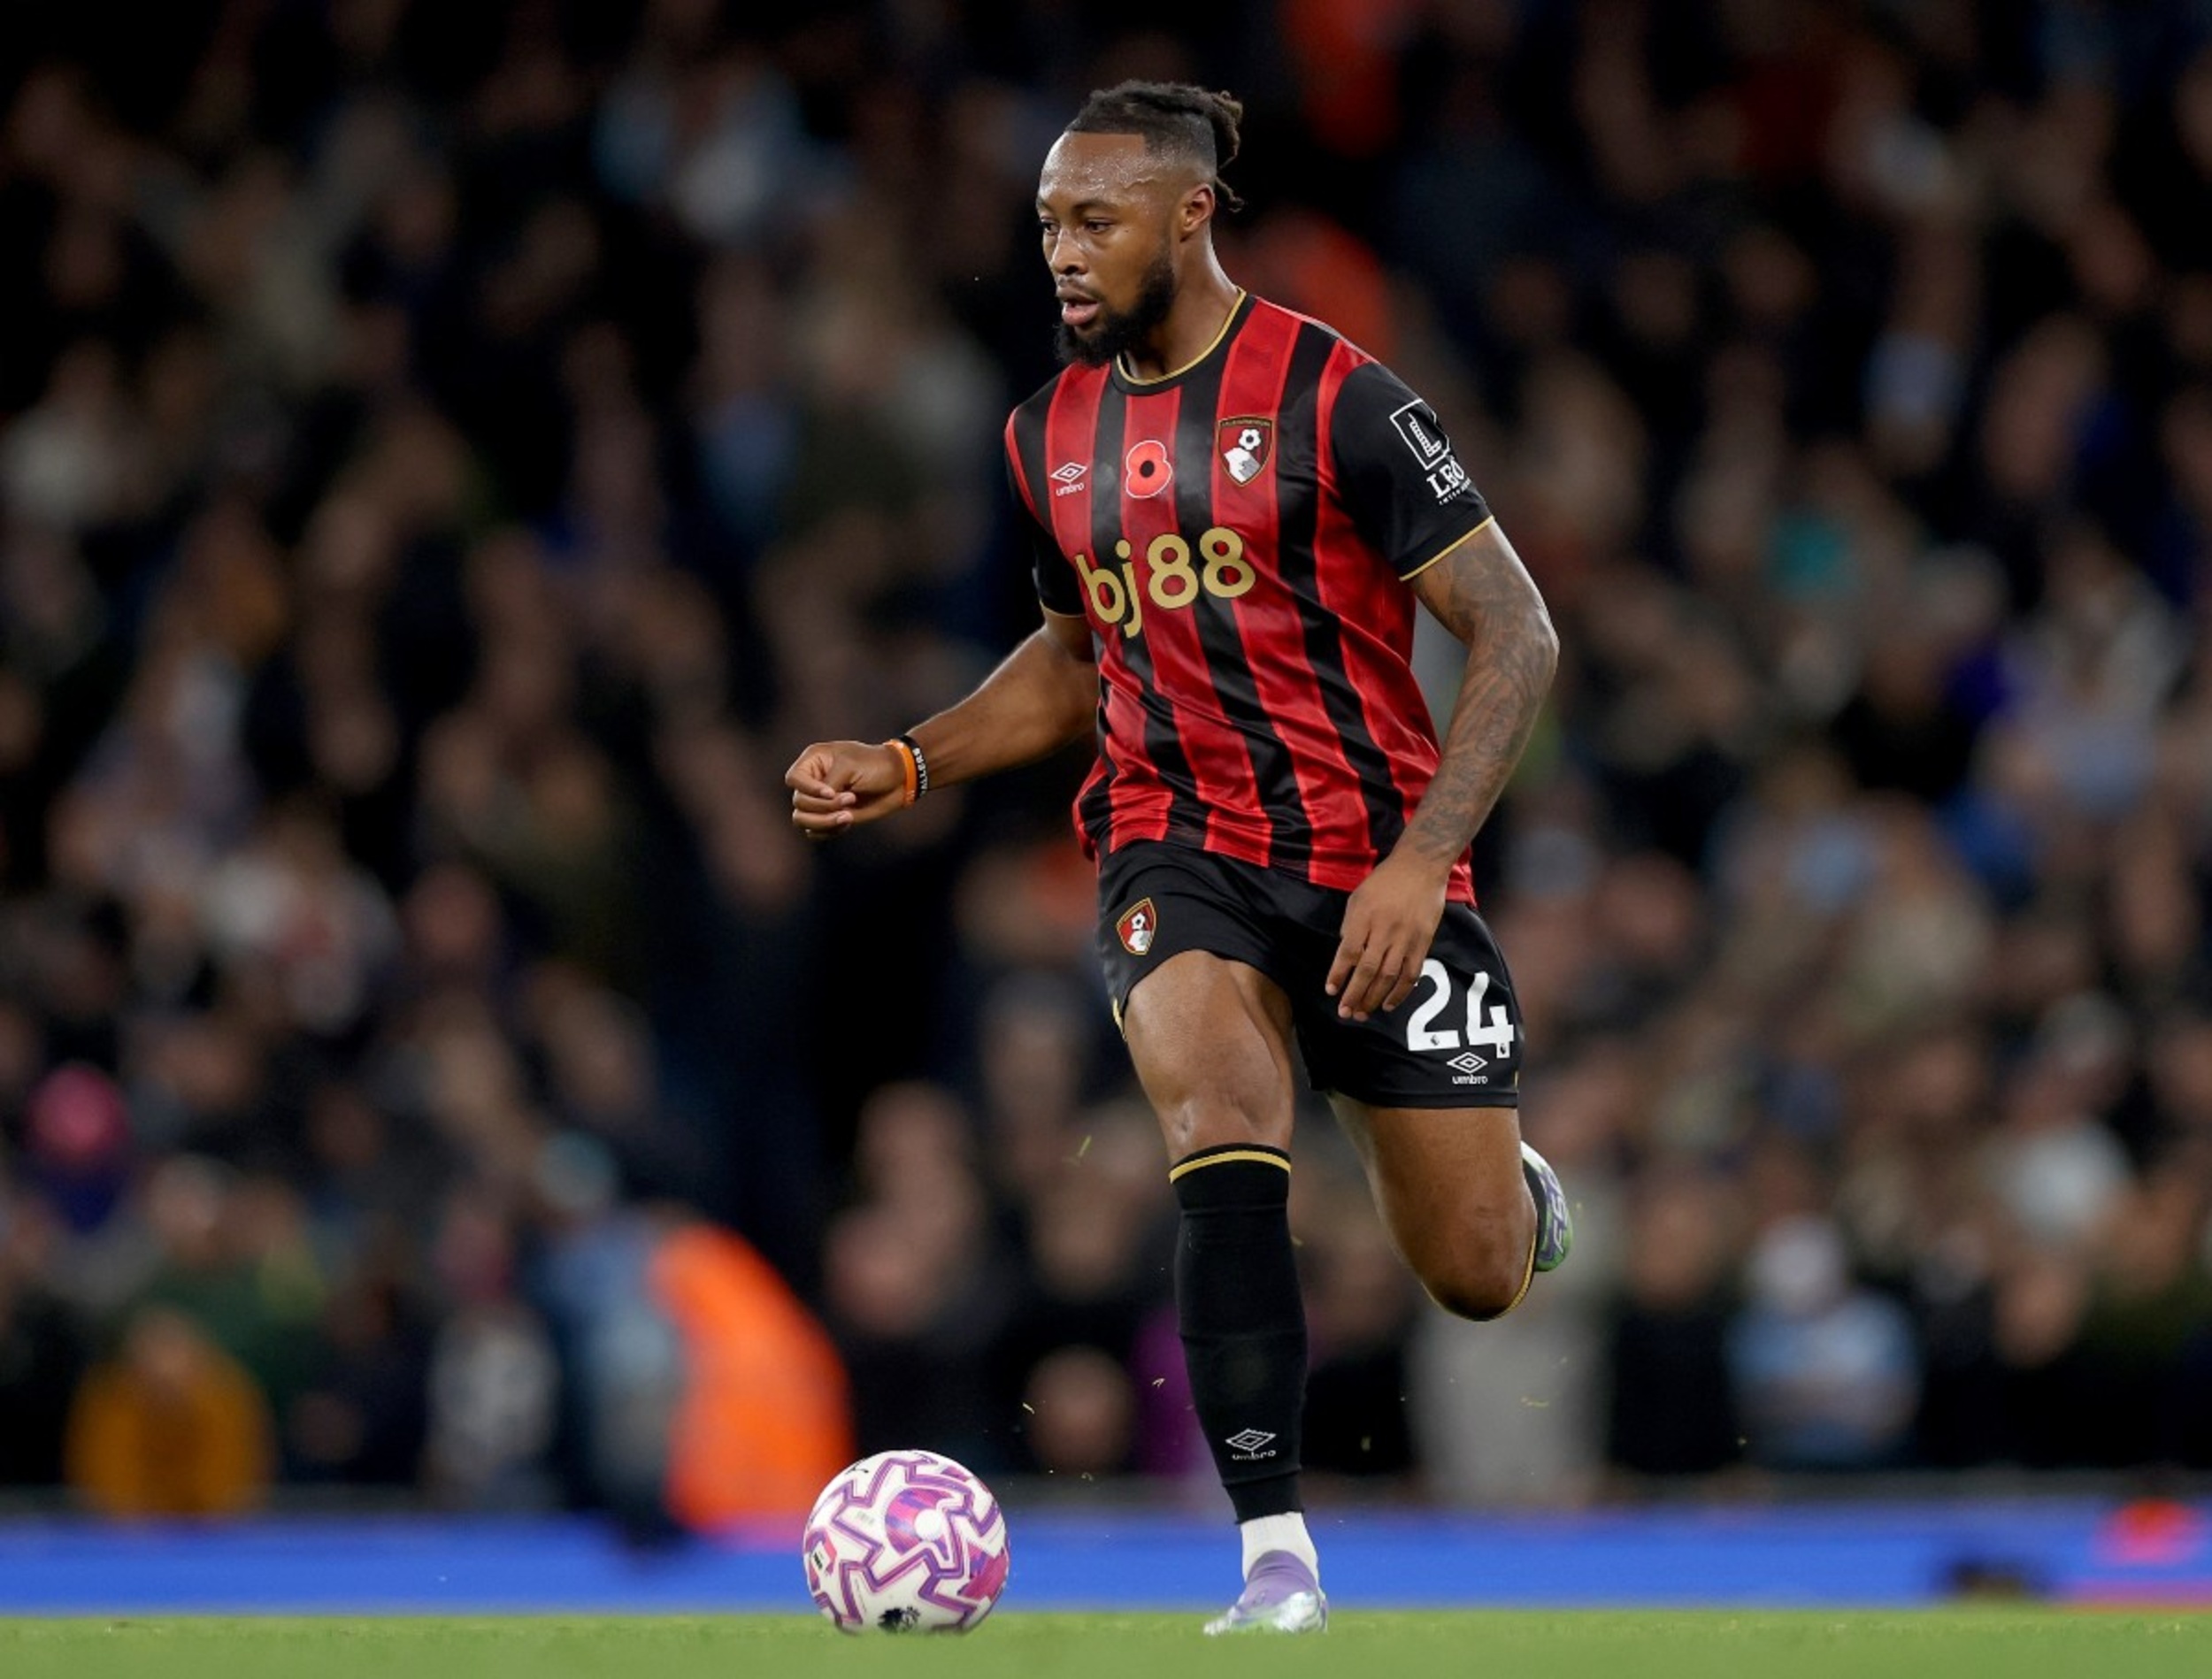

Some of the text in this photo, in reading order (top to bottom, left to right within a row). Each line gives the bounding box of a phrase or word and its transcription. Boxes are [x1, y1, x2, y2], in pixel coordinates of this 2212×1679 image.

[1056, 482, 1085, 496] umbro
[1074, 526, 1256, 639] bj88
[1407, 958, 1515, 1059] 24
[1452, 1074, 1488, 1085] umbro
[1232, 1450, 1277, 1460] umbro
